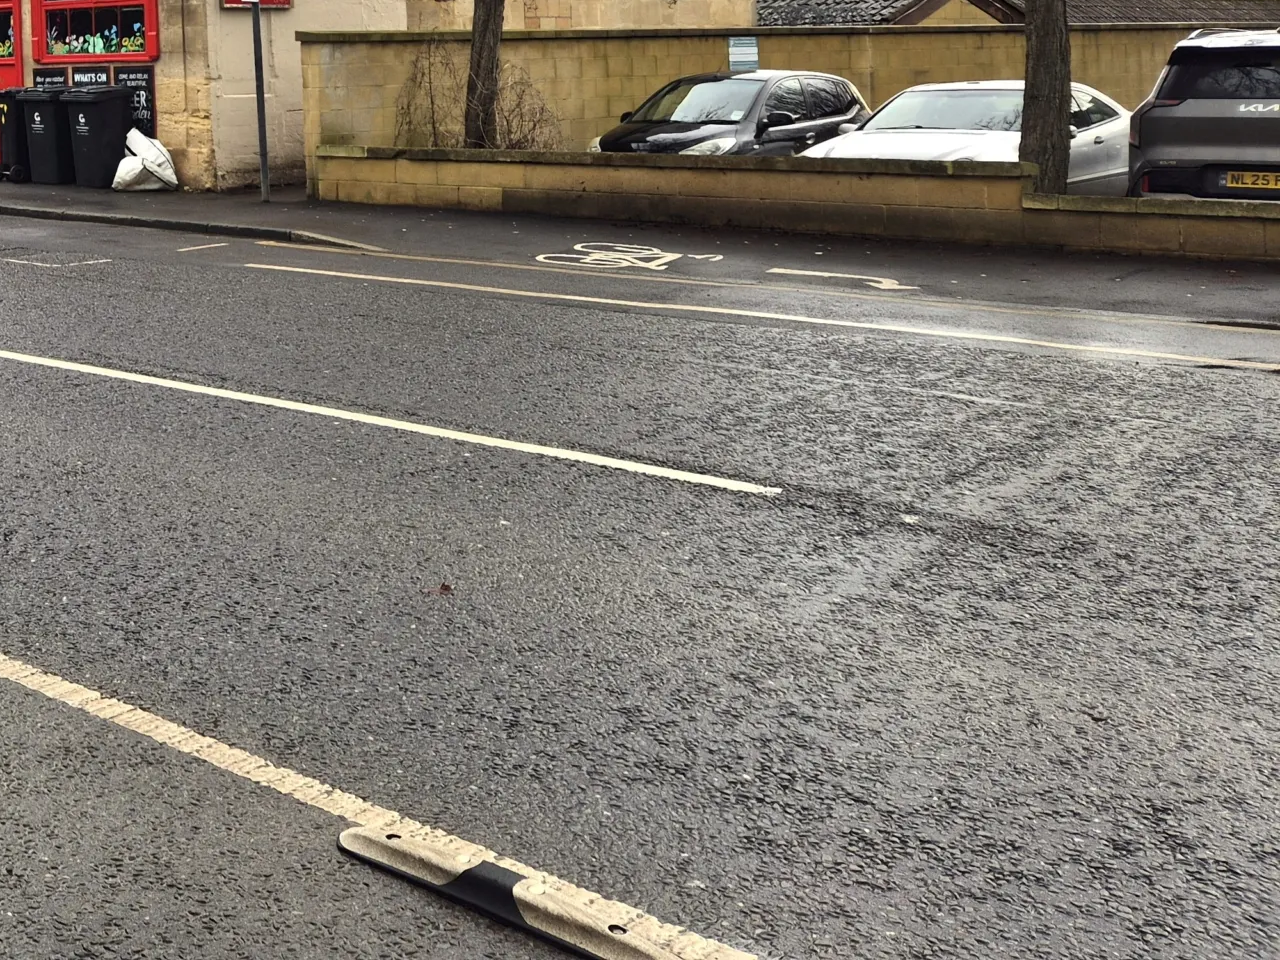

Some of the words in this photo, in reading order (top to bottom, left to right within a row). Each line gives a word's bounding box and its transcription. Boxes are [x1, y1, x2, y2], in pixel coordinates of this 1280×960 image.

[96, 73, 107, 82] ON
[1239, 103, 1280, 112] KIA
[1230, 173, 1270, 186] NL25
